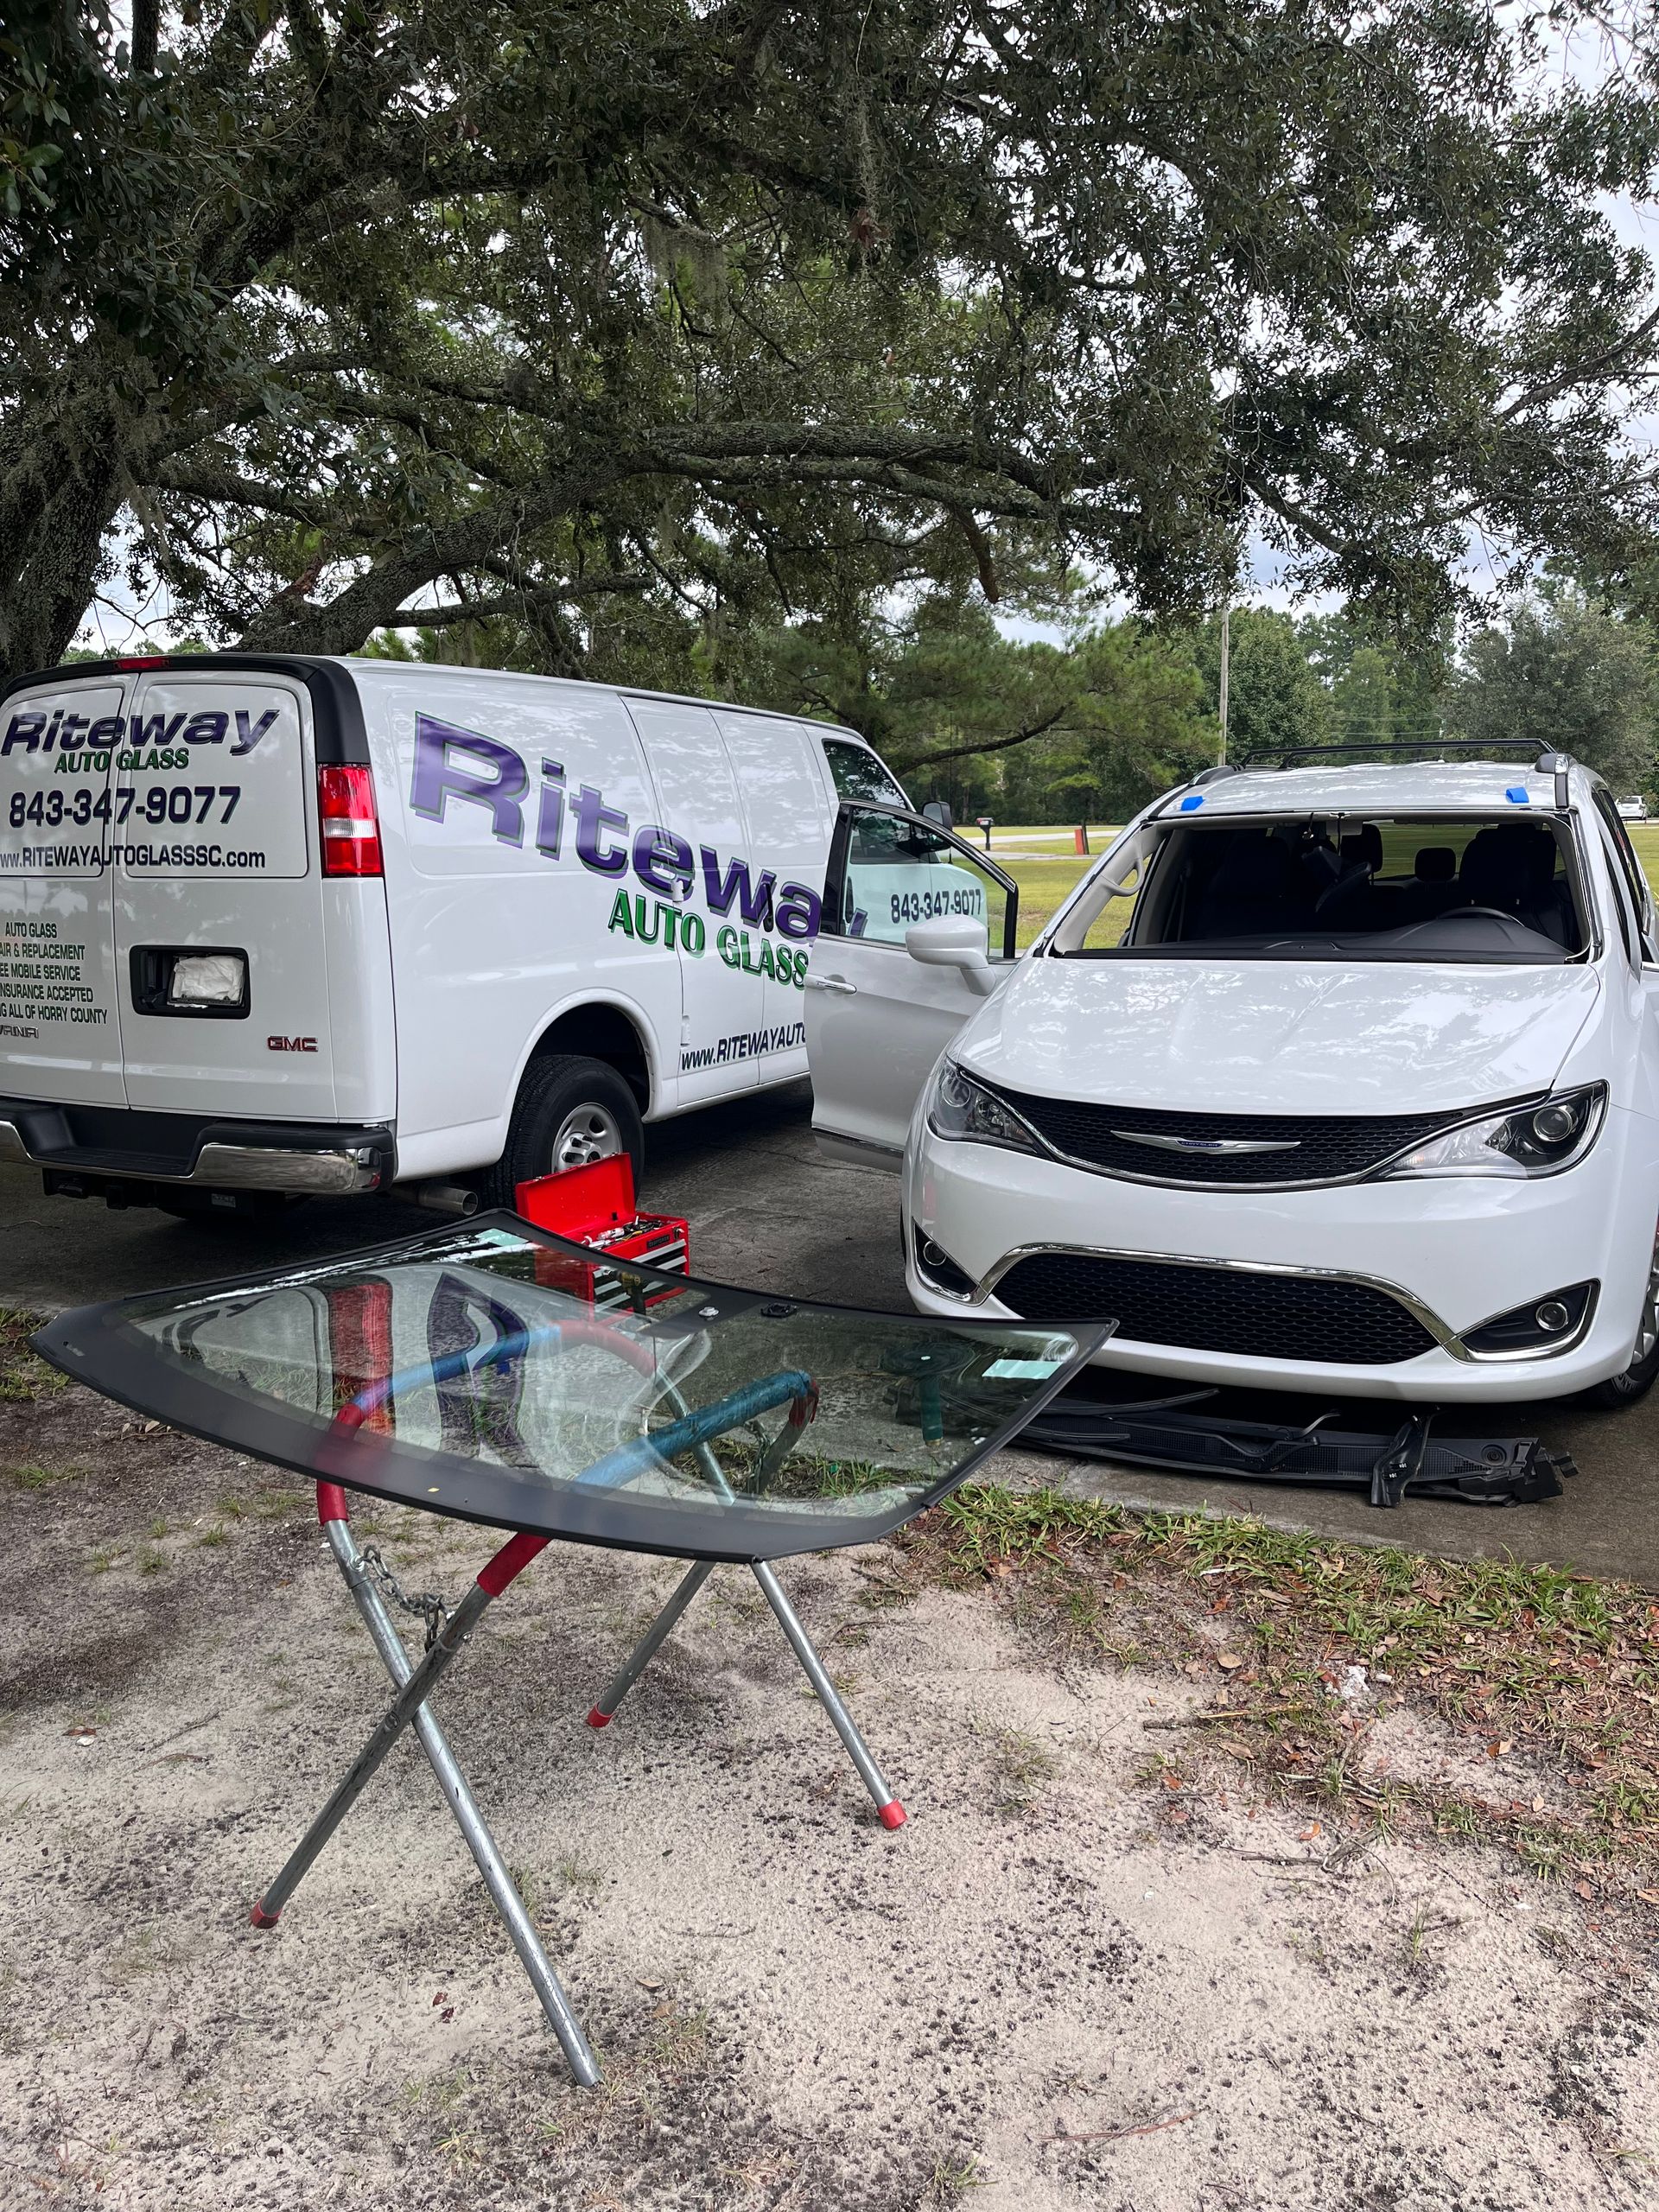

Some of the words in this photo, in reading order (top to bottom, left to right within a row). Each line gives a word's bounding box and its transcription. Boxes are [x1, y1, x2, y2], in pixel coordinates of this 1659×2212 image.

[1, 709, 280, 756] Riteway
[54, 750, 111, 773] AUTO
[116, 747, 189, 770] GLASS
[10, 785, 240, 828] 843-347-9077
[891, 888, 982, 924] 843-347-9077
[5, 922, 27, 937] AUTO
[29, 923, 57, 938] GLASS
[607, 887, 705, 958] AUTO
[716, 925, 809, 991] GLASS
[14, 943, 20, 957] &
[22, 943, 85, 960] REPLACEMENT
[11, 963, 41, 979] MOBILE
[44, 964, 80, 981] SERVICE
[47, 985, 93, 1002] ACCEPTED
[10, 1003, 23, 1018] ALL
[25, 1004, 35, 1020] OF
[38, 1005, 68, 1021] HORRY
[71, 1007, 107, 1024] COUNTY
[268, 1035, 318, 1052] GMC
